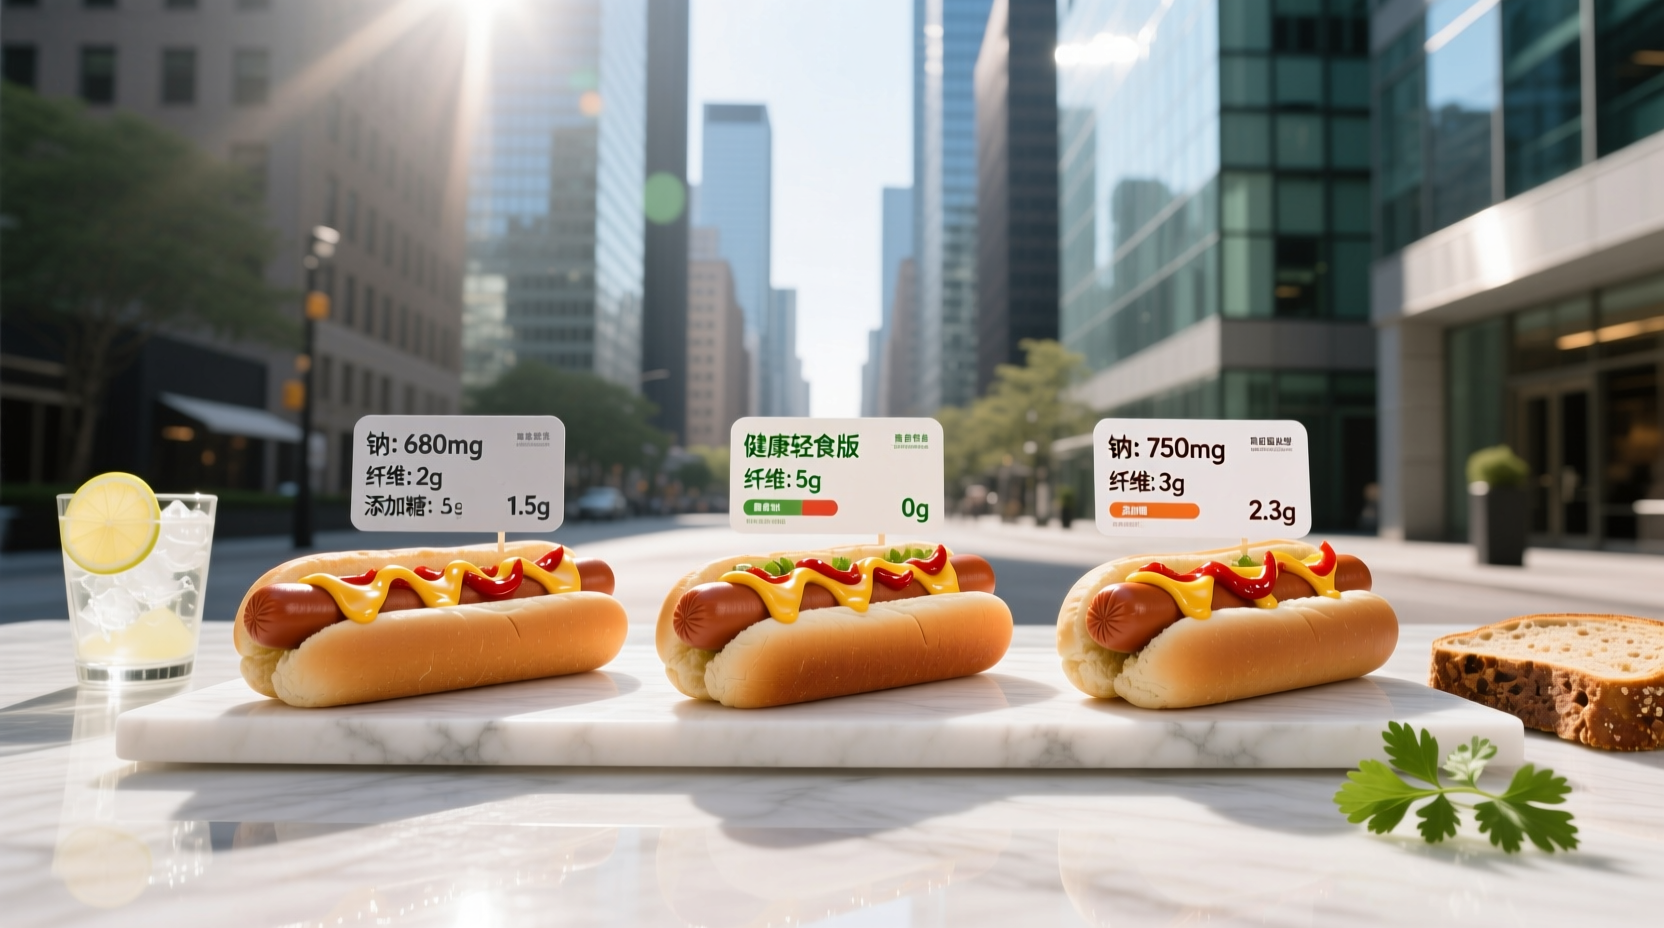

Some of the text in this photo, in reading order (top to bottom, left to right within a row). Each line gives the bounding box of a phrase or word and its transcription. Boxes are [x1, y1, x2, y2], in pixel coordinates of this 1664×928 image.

[404, 434, 482, 460] 680mg
[744, 433, 859, 458] 健康轻食版
[1147, 437, 1225, 465] 750mg
[508, 495, 549, 520] 1.5g
[902, 498, 928, 523] 0g
[1249, 500, 1295, 526] 2.3g
